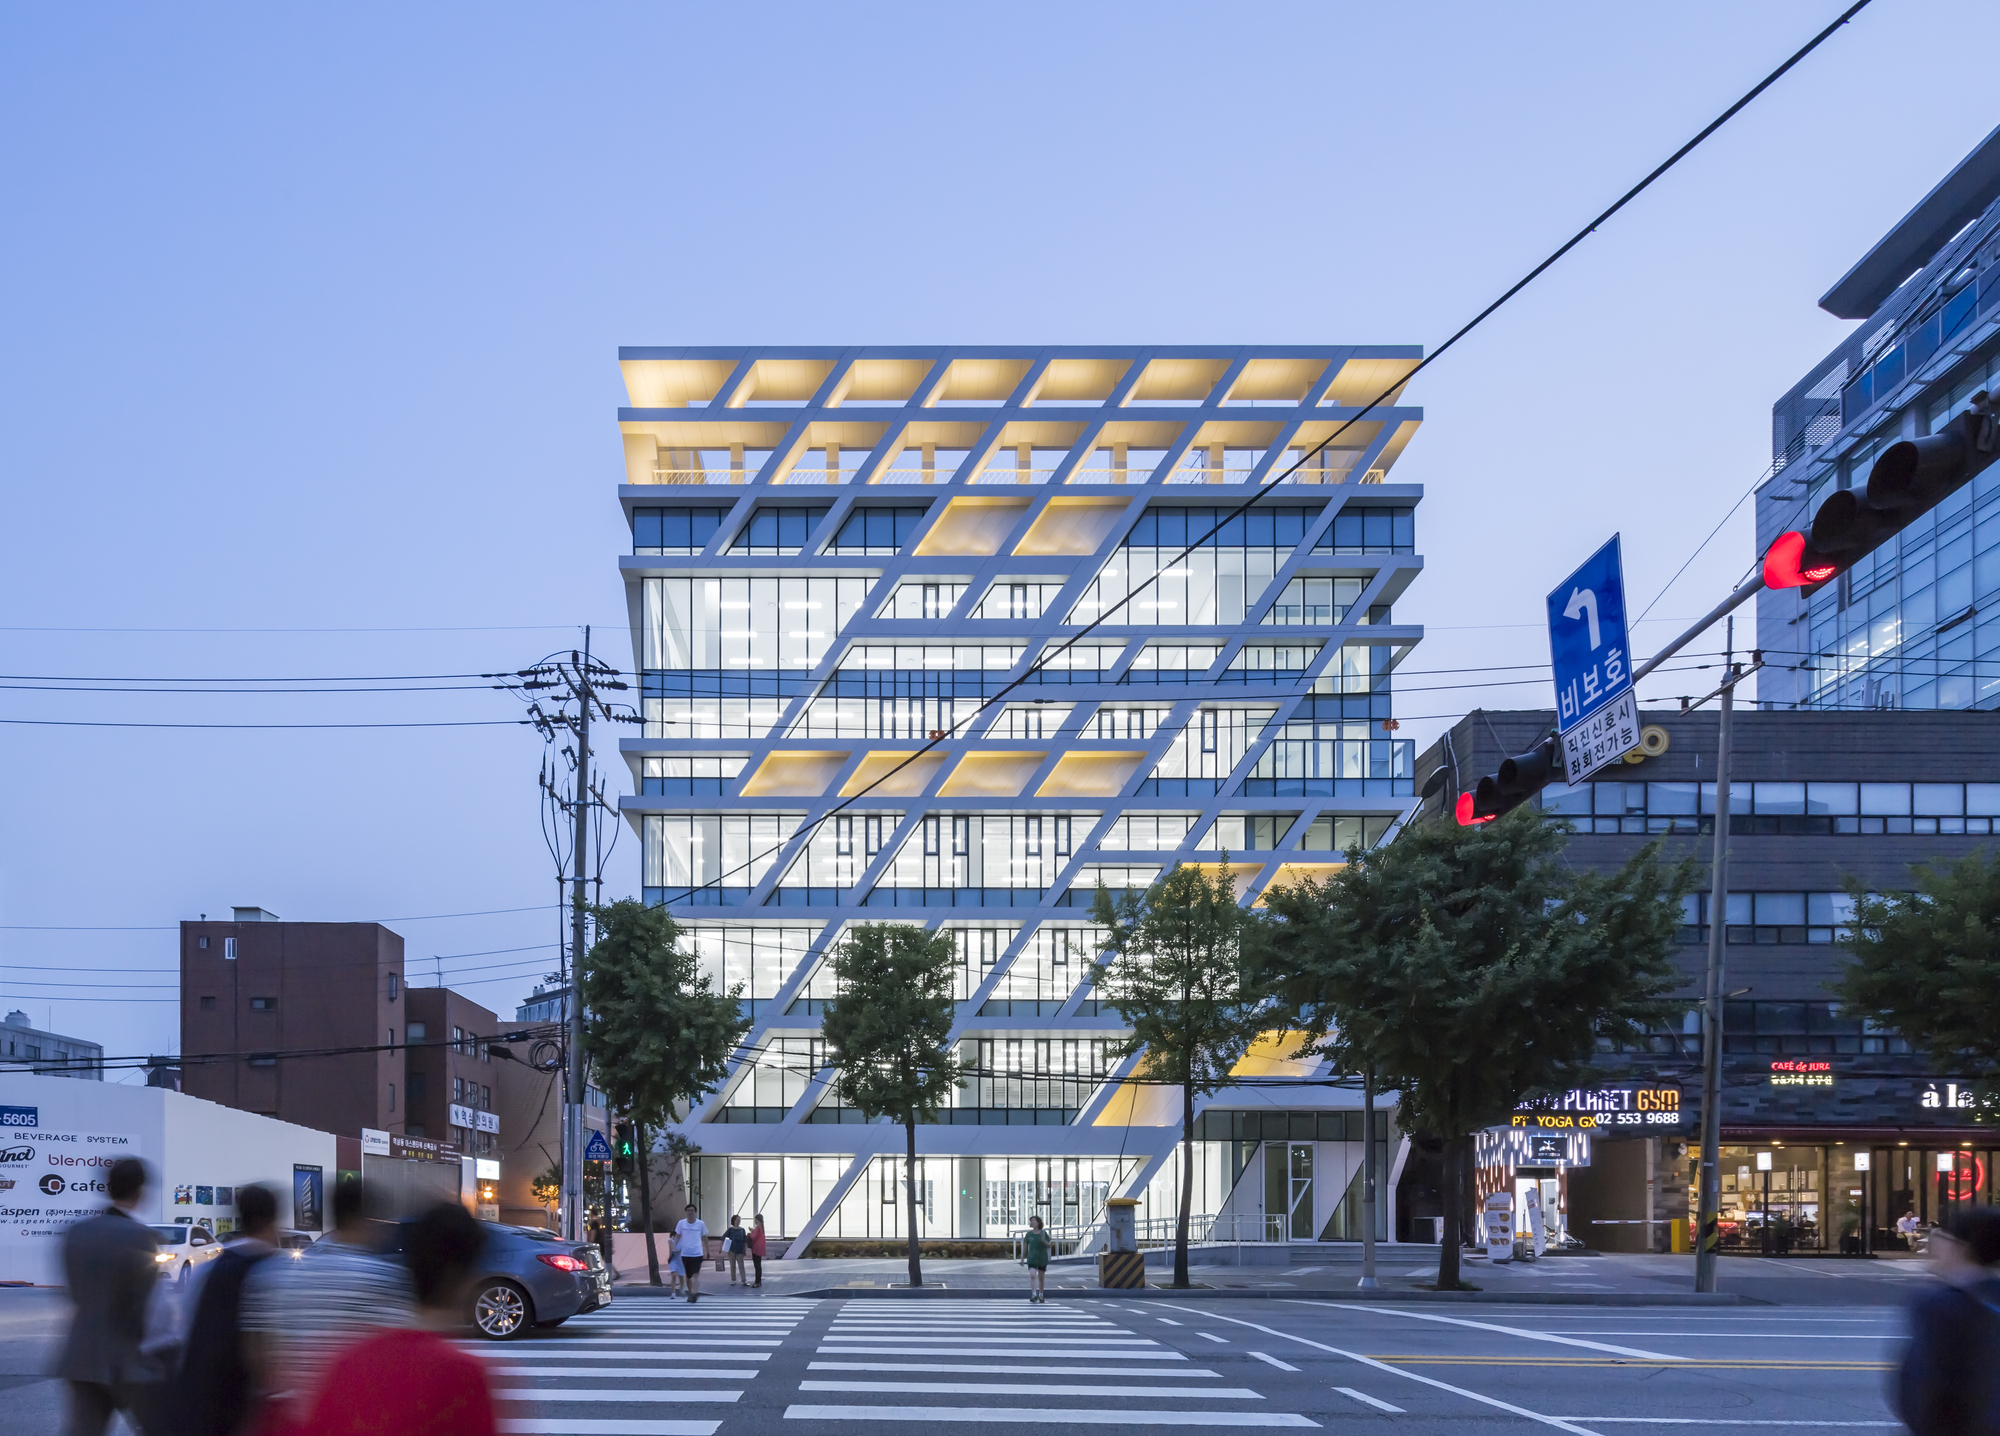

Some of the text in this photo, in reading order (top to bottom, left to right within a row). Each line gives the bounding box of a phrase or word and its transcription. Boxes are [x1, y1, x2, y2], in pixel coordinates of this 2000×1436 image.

[1560, 647, 1626, 720] 비보호
[1568, 700, 1630, 753] 직진신호시
[1571, 727, 1633, 776] 좌회전가능
[1771, 1061, 1794, 1070] CAFÉ
[1796, 1062, 1807, 1072] de
[1565, 1090, 1631, 1110] PLANET
[1637, 1090, 1679, 1110] GYM
[1537, 1116, 1574, 1127] YOGA
[1579, 1116, 1597, 1127] GX
[1595, 1113, 1679, 1124] 02 553 9688
[14, 1132, 128, 1144] BEVERAGE SYSTEM
[48, 1154, 114, 1168] blendte
[1, 1208, 40, 1218] aspen
